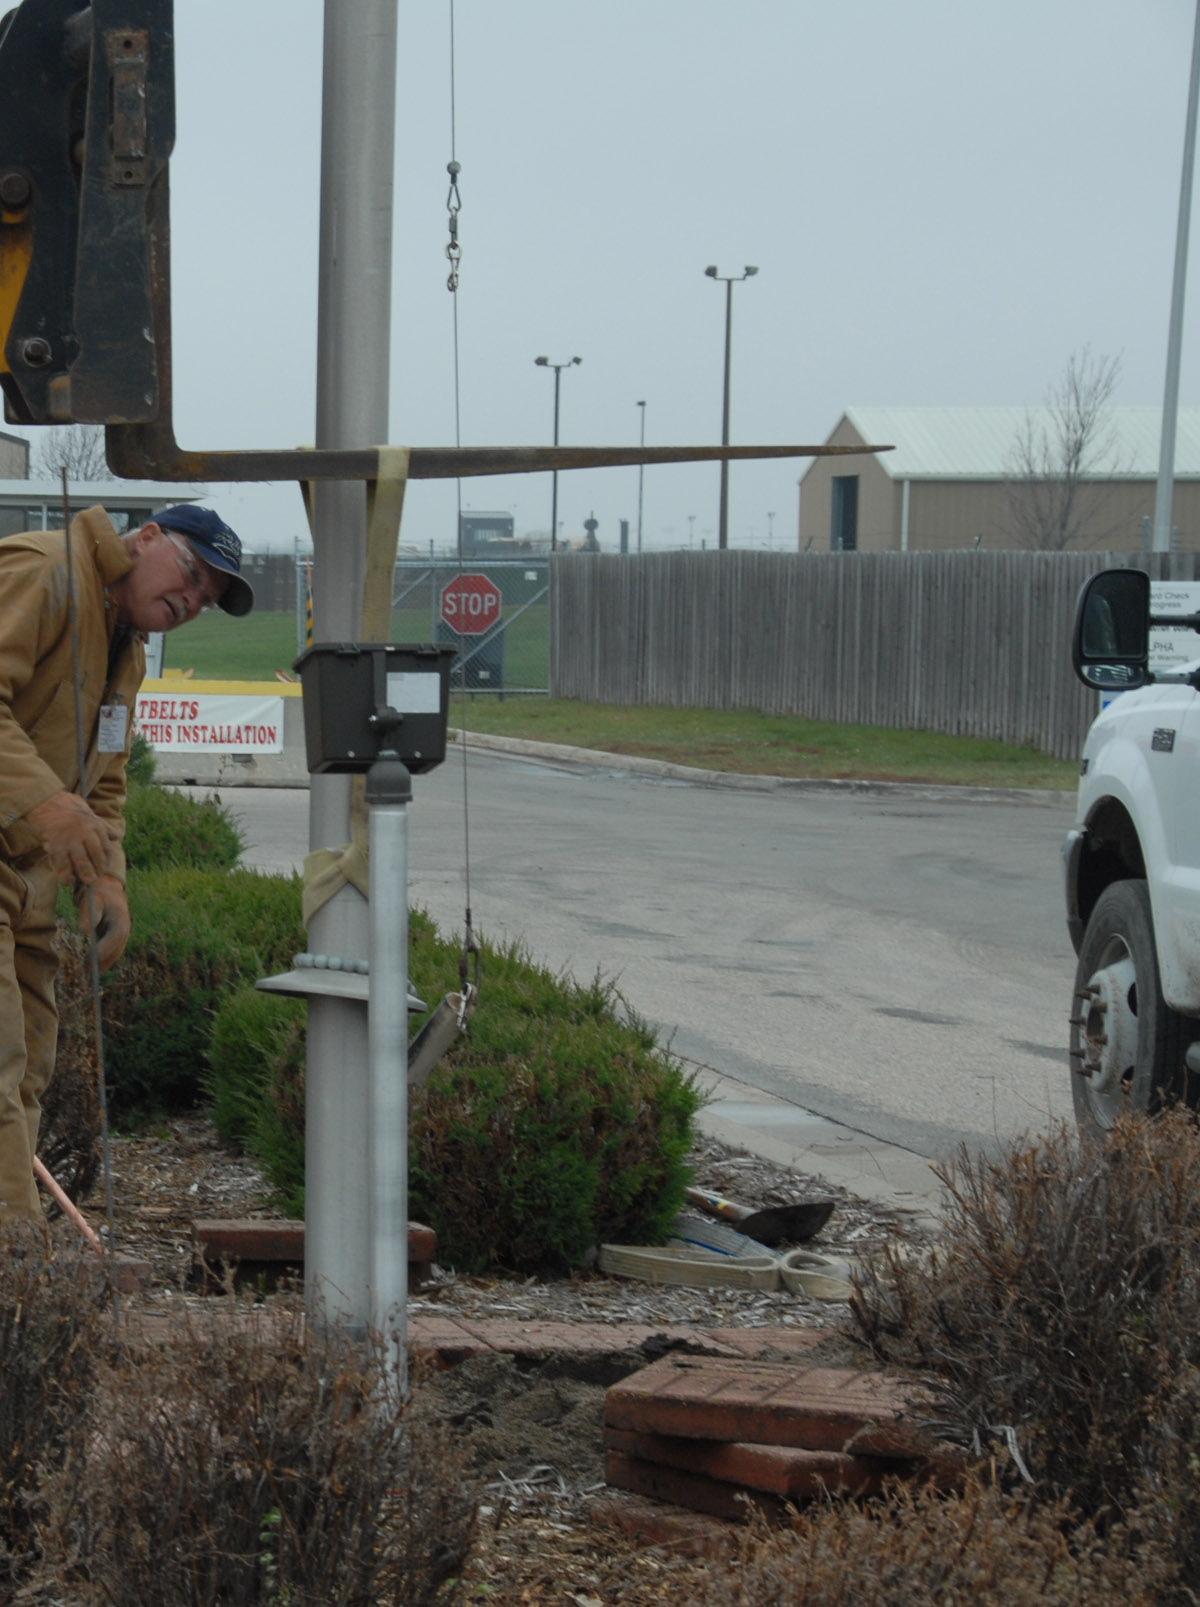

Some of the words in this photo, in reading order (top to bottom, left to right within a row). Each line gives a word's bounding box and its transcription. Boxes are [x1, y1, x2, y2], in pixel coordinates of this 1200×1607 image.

[444, 592, 497, 616] STOP
[1151, 601, 1182, 610] rogress
[133, 700, 199, 720] TBELTS
[141, 724, 173, 744] THIS
[176, 725, 278, 745] INSTALLATION
